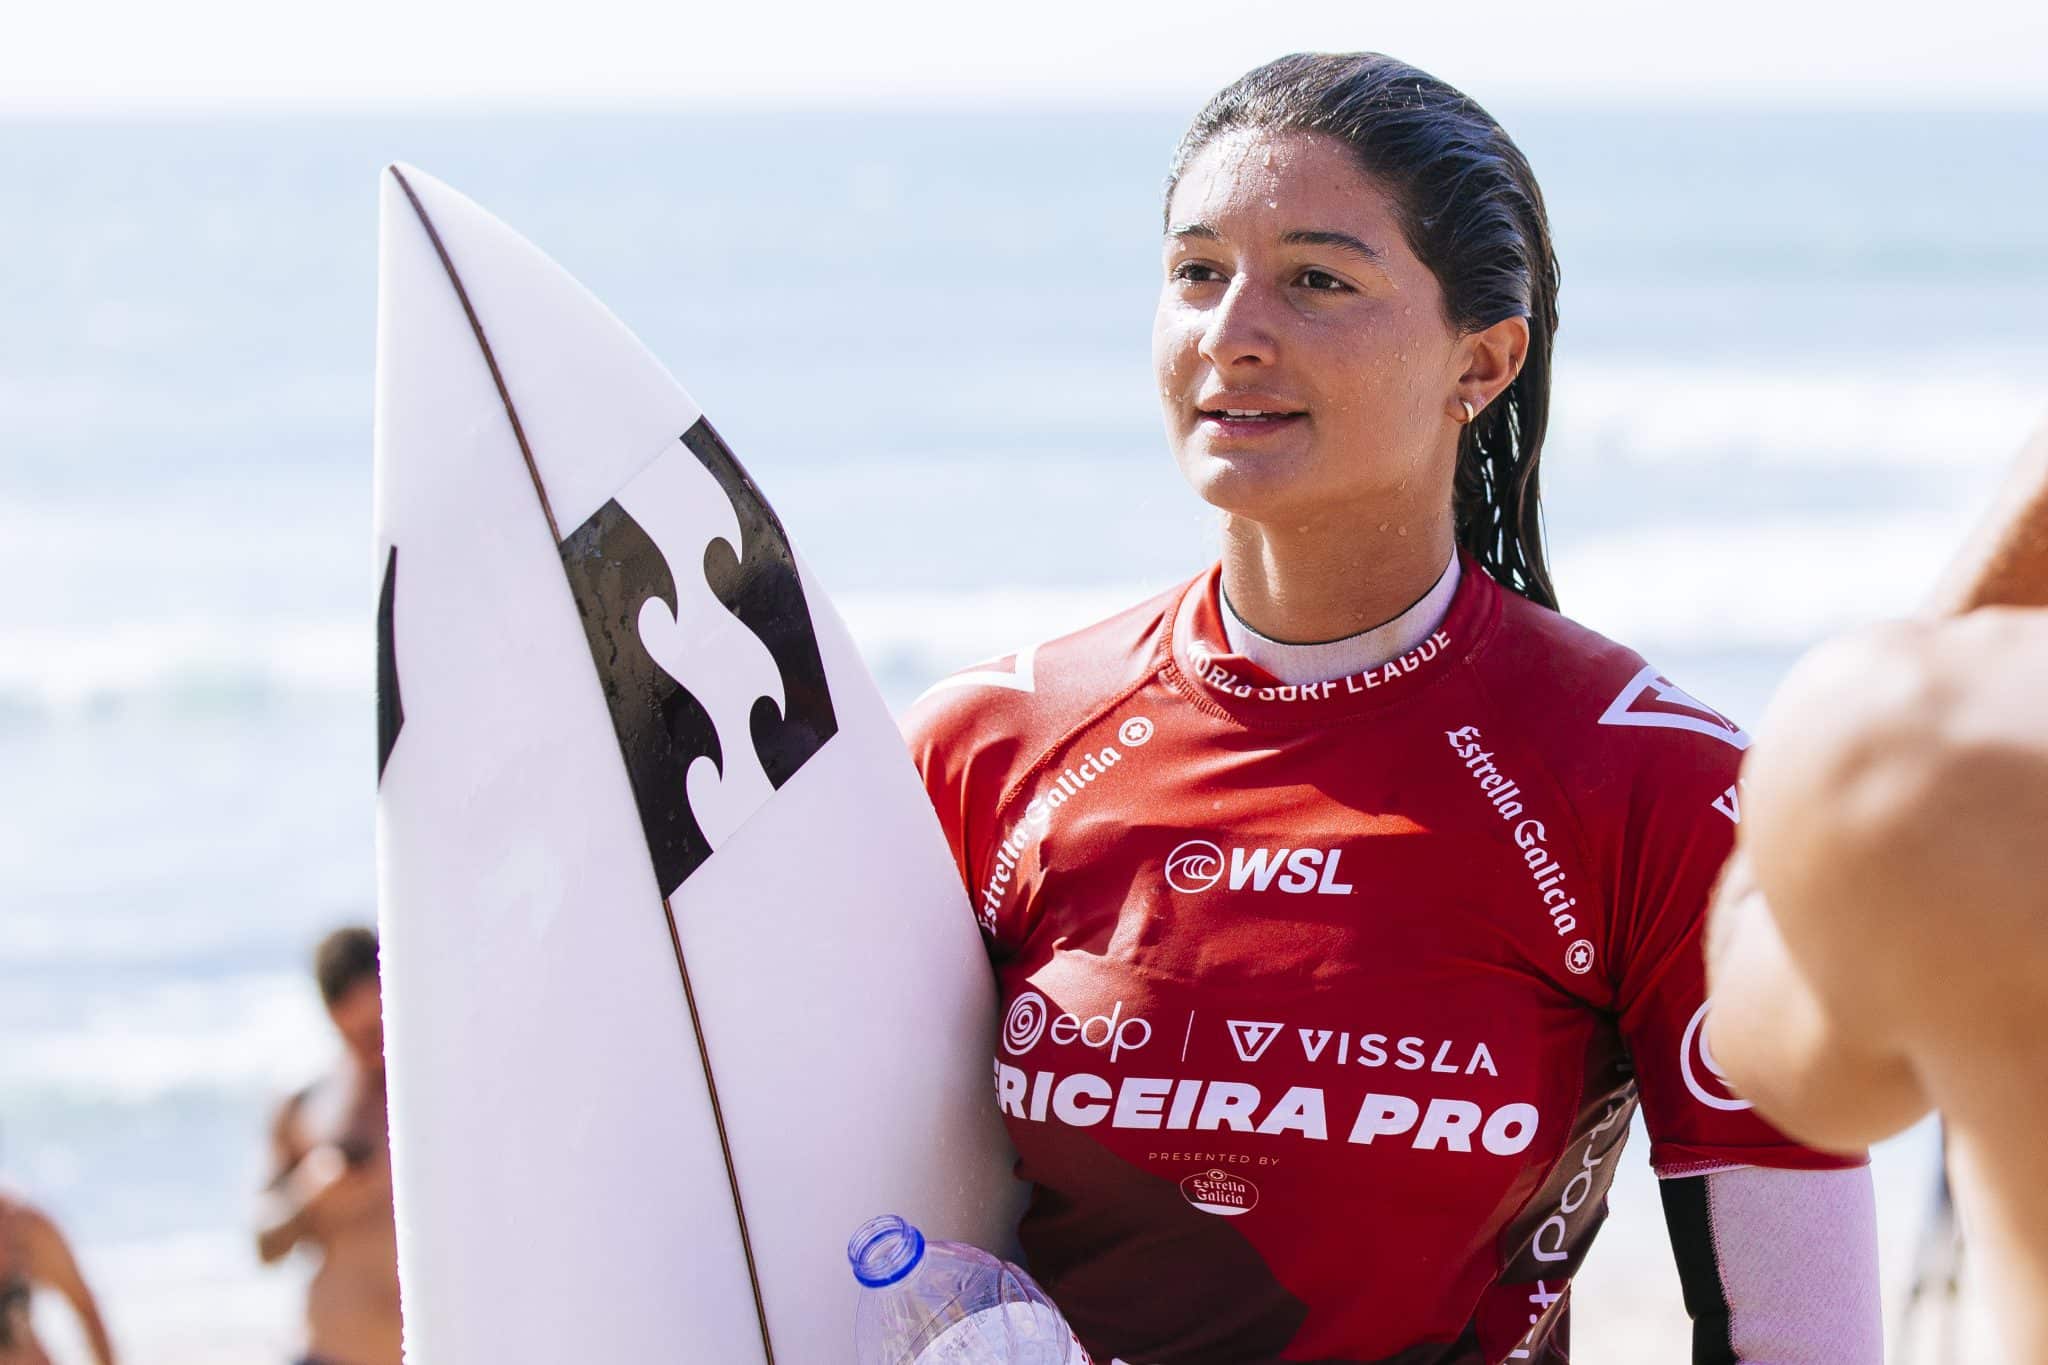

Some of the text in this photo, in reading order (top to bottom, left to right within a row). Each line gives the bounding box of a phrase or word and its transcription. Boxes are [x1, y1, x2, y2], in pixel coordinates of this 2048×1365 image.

[1346, 629, 1451, 694] LEAGUE
[977, 746, 1122, 937] Estrella Galicia
[1445, 725, 1577, 936] Estrella Galicia
[1228, 847, 1354, 895] WSL
[1050, 1000, 1499, 1077] edp VISSLA
[1347, 1093, 1540, 1157] PRO
[1148, 1152, 1280, 1167] PRESENTED BY
[1193, 1179, 1246, 1193] Estrella
[1196, 1188, 1244, 1205] Galicia
